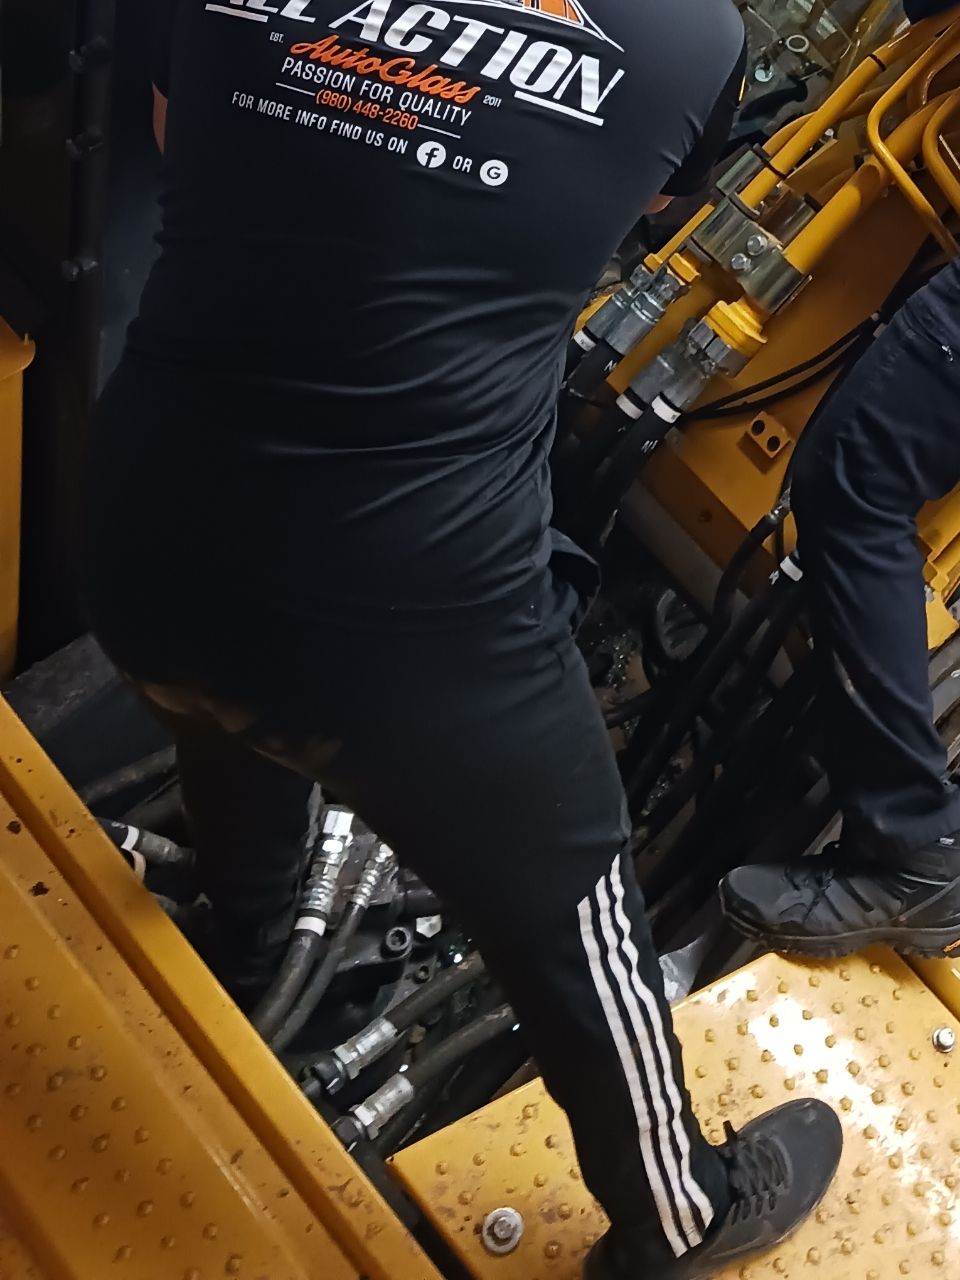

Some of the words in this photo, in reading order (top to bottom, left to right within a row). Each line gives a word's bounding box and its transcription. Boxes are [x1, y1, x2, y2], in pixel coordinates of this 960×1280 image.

[270, 32, 284, 43] EST.
[290, 35, 481, 103] AutoGlass
[483, 94, 501, 108] 2011
[281, 57, 356, 92] PASSION
[359, 80, 393, 103] FOR
[399, 92, 471, 126] QUALITY
[232, 92, 254, 109] FOR
[257, 99, 290, 120] MORE
[295, 109, 325, 130] INFO
[330, 120, 362, 140] FIND
[366, 130, 382, 147] US
[388, 137, 408, 154] ON
[453, 156, 472, 172] OR
[316, 88, 351, 112] (980)
[353, 100, 418, 130] 448-2260
